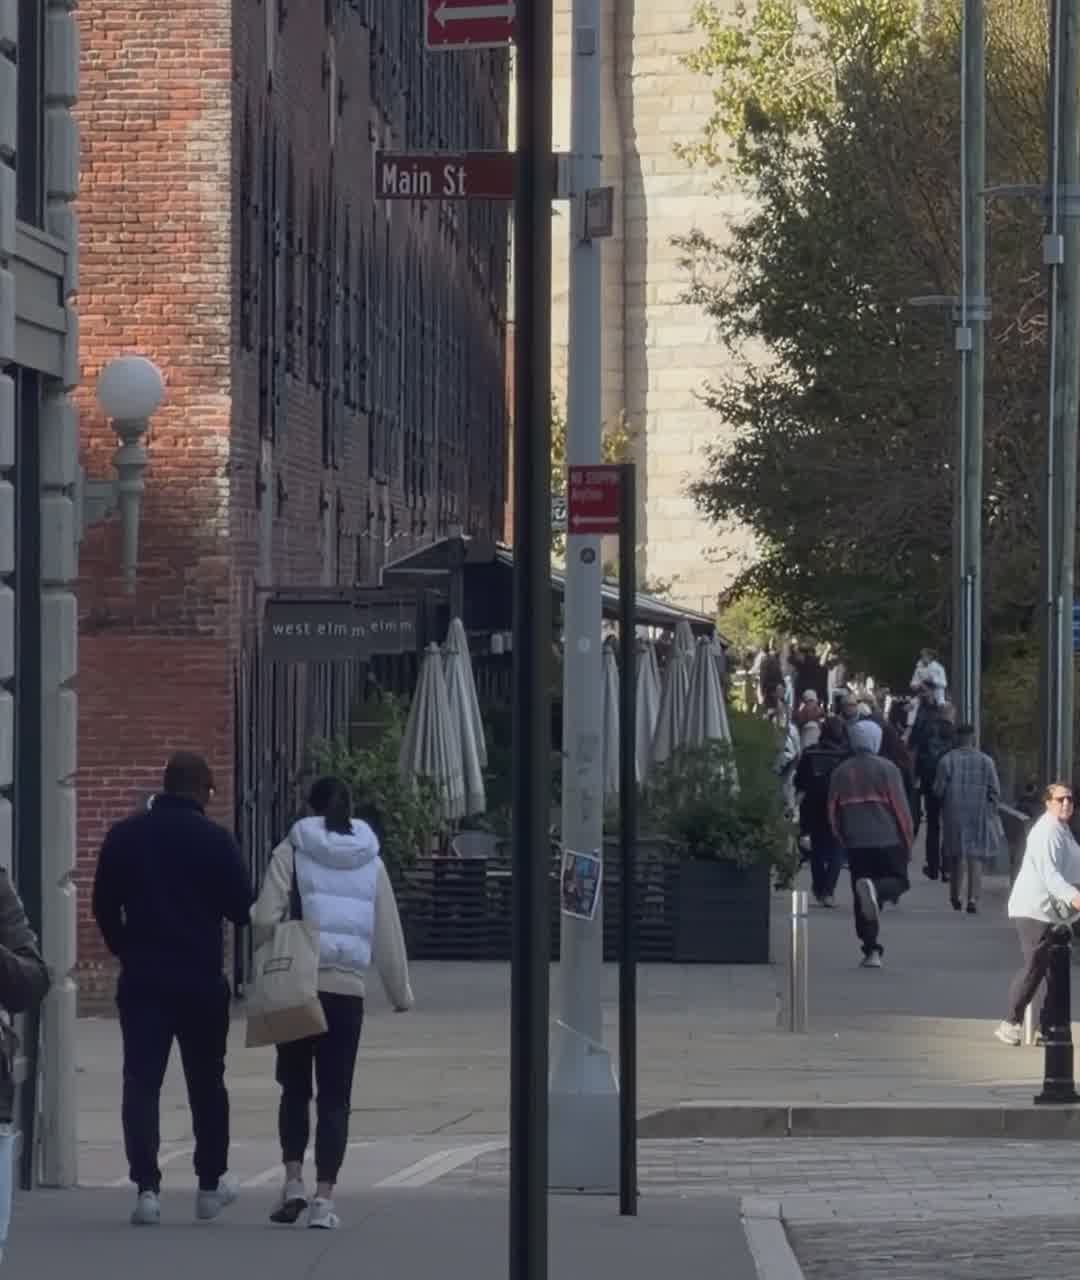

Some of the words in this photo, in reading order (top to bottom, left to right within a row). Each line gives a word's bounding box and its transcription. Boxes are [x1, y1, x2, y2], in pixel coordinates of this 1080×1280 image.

[382, 163, 432, 195] Main
[442, 163, 467, 196] St
[272, 620, 312, 636] west
[317, 619, 348, 637] elm
